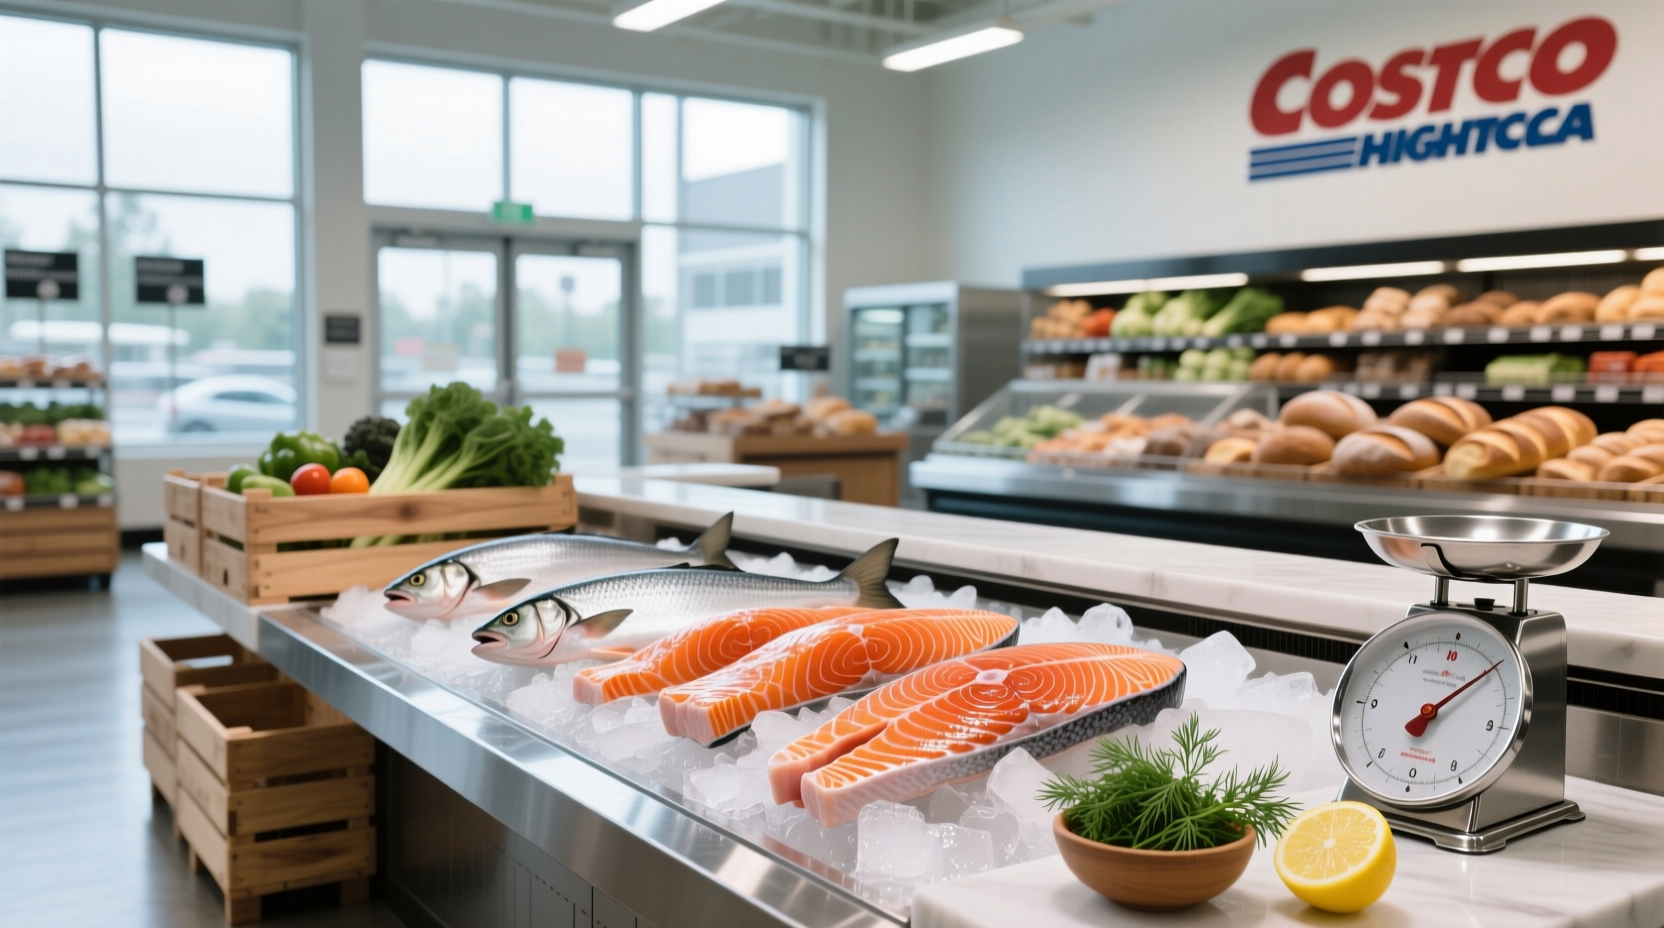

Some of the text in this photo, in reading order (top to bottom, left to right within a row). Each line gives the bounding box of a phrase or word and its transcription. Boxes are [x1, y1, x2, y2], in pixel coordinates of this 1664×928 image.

[1249, 15, 1617, 136] COSTCO
[1359, 102, 1595, 166] HIGHTCCA
[1446, 649, 1458, 662] 10
